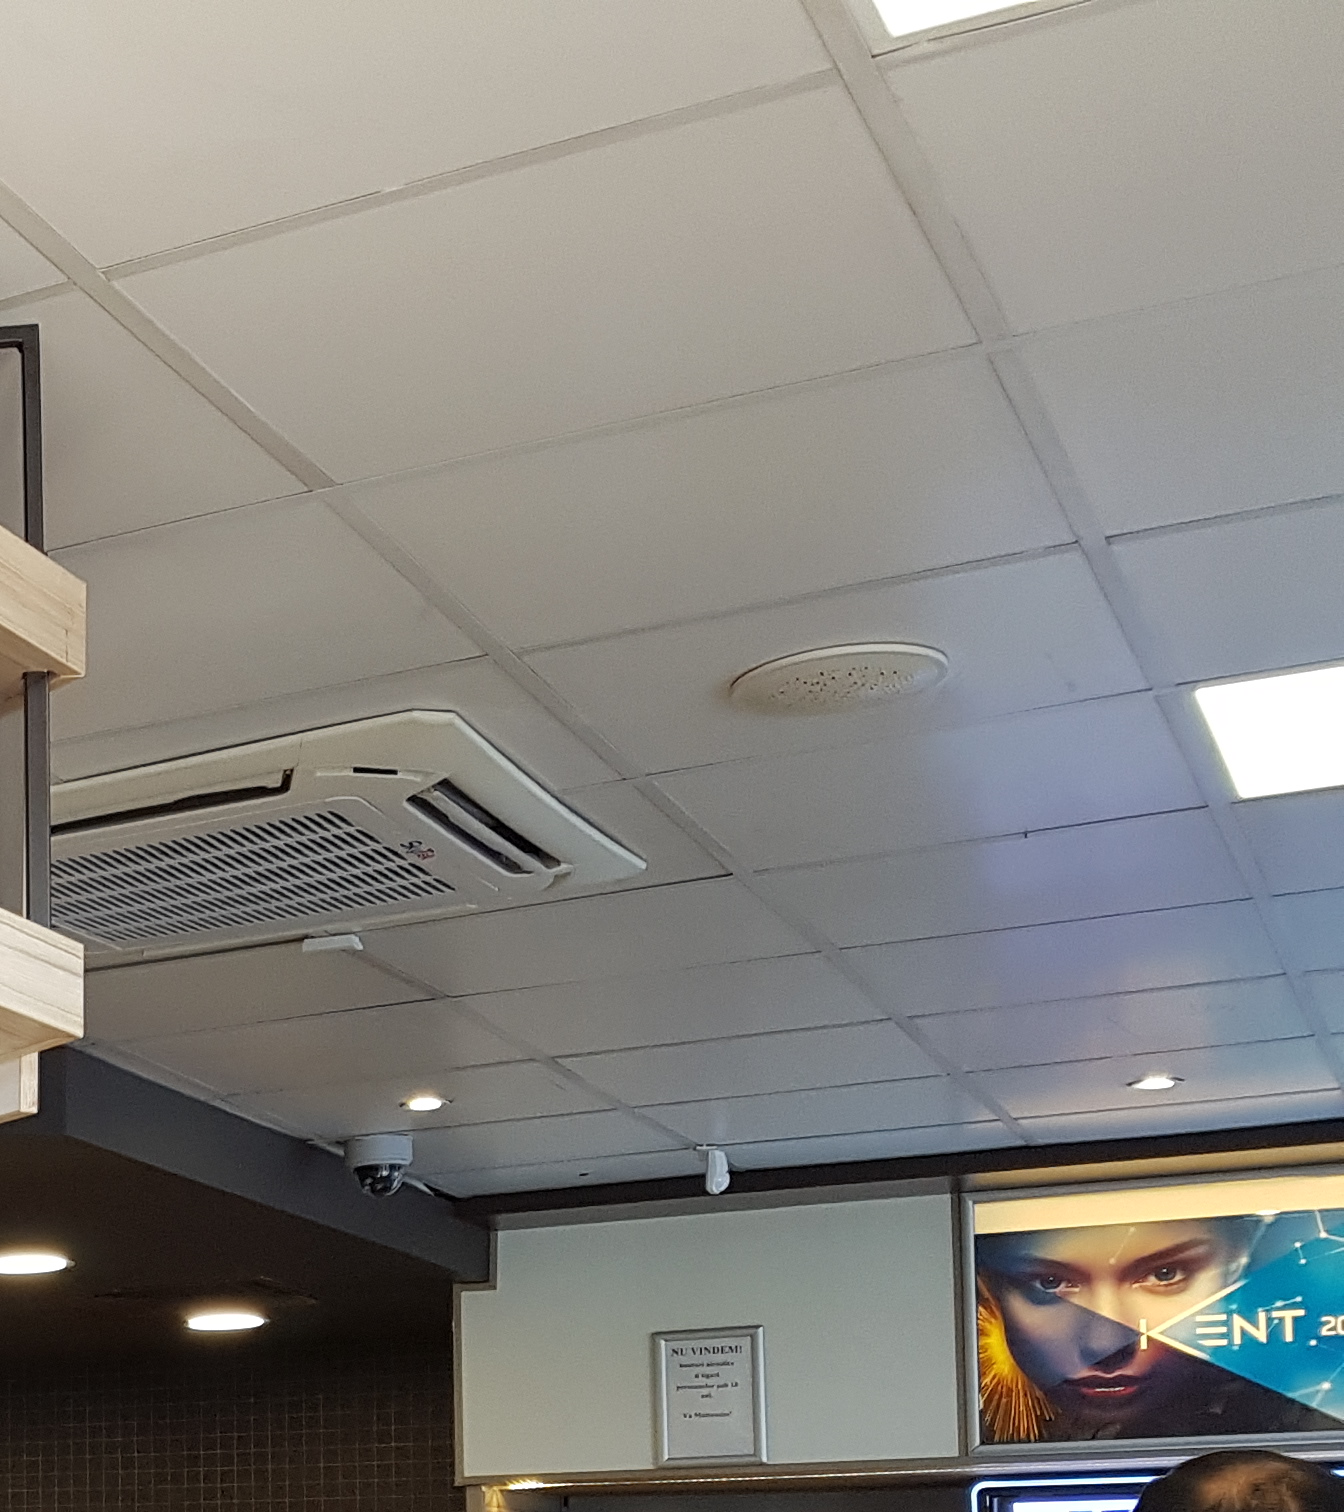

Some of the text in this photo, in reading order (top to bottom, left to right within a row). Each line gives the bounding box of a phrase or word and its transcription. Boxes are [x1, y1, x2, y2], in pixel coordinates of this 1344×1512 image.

[1139, 1279, 1306, 1360] KENT
[671, 1345, 742, 1356] NU VINDEM!
